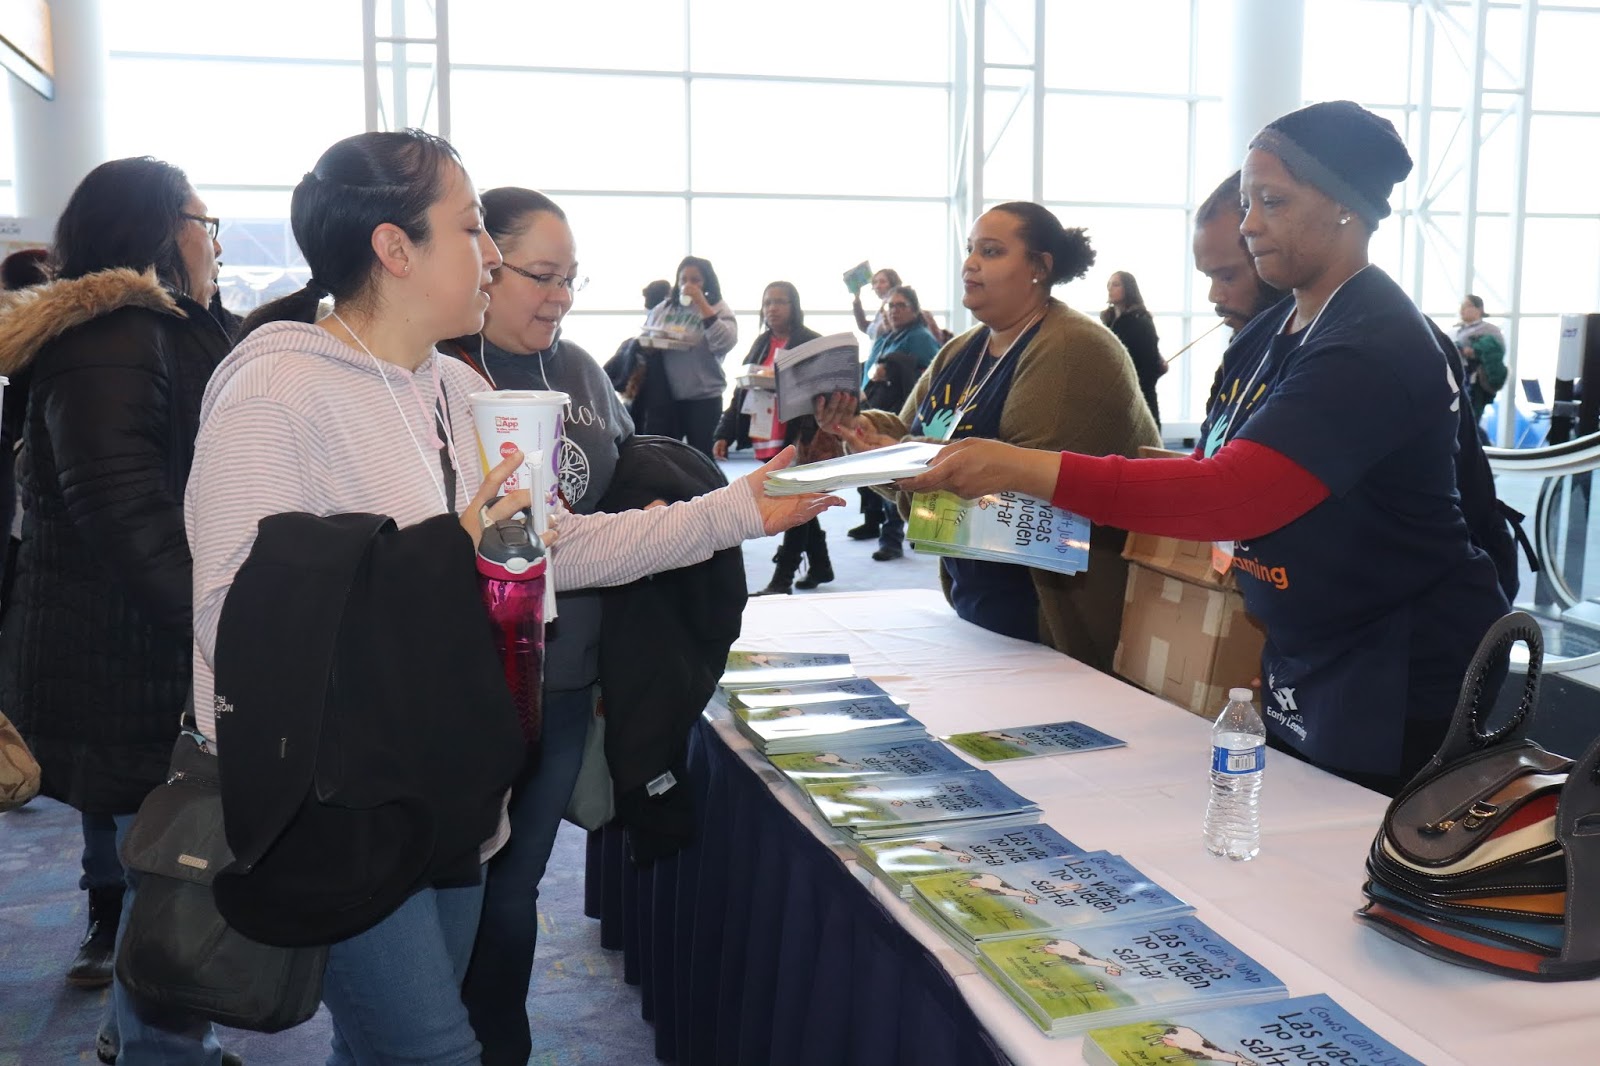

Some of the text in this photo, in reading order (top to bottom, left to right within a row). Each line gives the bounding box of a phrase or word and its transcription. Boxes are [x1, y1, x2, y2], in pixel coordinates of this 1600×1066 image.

[997, 491, 1018, 527] altar
[1015, 498, 1036, 546] pueden
[1036, 505, 1054, 544] vacas
[852, 703, 874, 714] Las
[1267, 706, 1287, 726] Early
[891, 746, 915, 758] Las
[988, 838, 1009, 847] no
[1004, 832, 1031, 846] Las
[969, 845, 1006, 866] saltar
[996, 848, 1027, 863] pue
[1023, 847, 1049, 860] vac
[1049, 869, 1074, 882] no
[1064, 860, 1098, 880] Las
[1090, 857, 1118, 875] Cows
[1031, 880, 1081, 908] saltar
[1061, 883, 1118, 914] pueden
[1090, 881, 1136, 905] vacas
[1132, 935, 1160, 950] no
[1149, 927, 1187, 949] Las
[1177, 923, 1208, 943] Cows
[1113, 948, 1169, 980] saltar
[1146, 952, 1211, 989] pueden
[1178, 951, 1231, 981] vacas
[1278, 1012, 1323, 1039] Las
[1309, 1006, 1348, 1033] Cows
[1260, 1023, 1293, 1041] no
[1240, 1039, 1290, 1066] salt
[1280, 1044, 1330, 1066] pue
